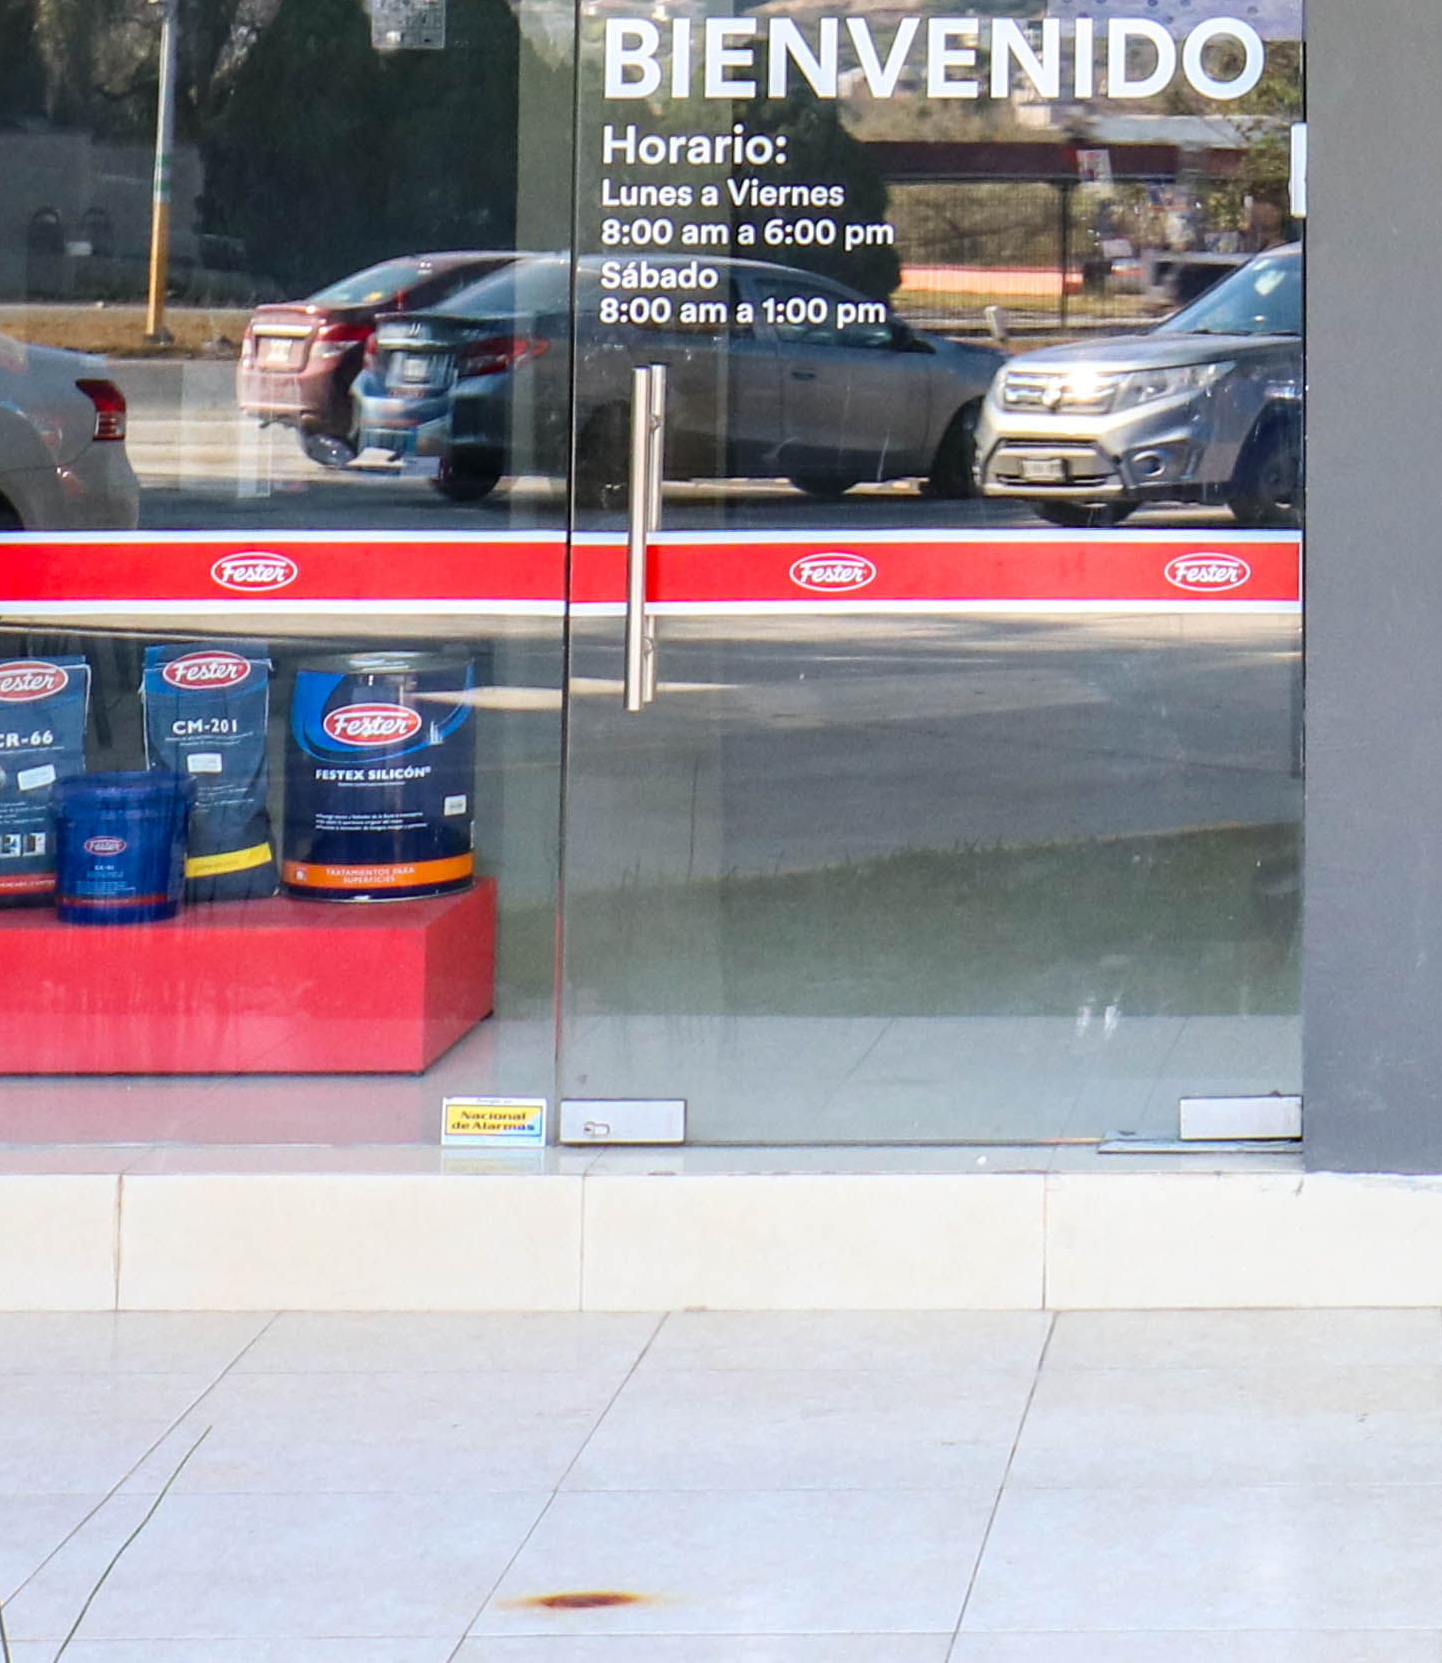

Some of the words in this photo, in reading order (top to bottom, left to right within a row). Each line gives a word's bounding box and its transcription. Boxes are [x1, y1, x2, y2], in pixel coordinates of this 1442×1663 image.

[603, 16, 1265, 100] BIENVENIDO
[602, 124, 787, 165] Horario:
[602, 179, 692, 208] Lunes
[700, 187, 717, 208] a
[727, 177, 845, 208] Viernes
[602, 219, 672, 247] 8:00
[681, 226, 729, 246] am
[737, 226, 755, 246] a
[764, 219, 836, 247] 6:00
[844, 226, 894, 254] pm
[600, 261, 719, 290] Sábado
[599, 297, 671, 325] 8:00
[679, 304, 728, 324] am
[736, 304, 753, 324] a
[762, 297, 828, 324] 1:00
[836, 303, 886, 330] pm
[171, 718, 237, 736] CM-201
[315, 768, 364, 781] FESTEX
[452, 1121, 470, 1130] de
[472, 1121, 535, 1131] Alarmas
[461, 1111, 527, 1121] Nacional
